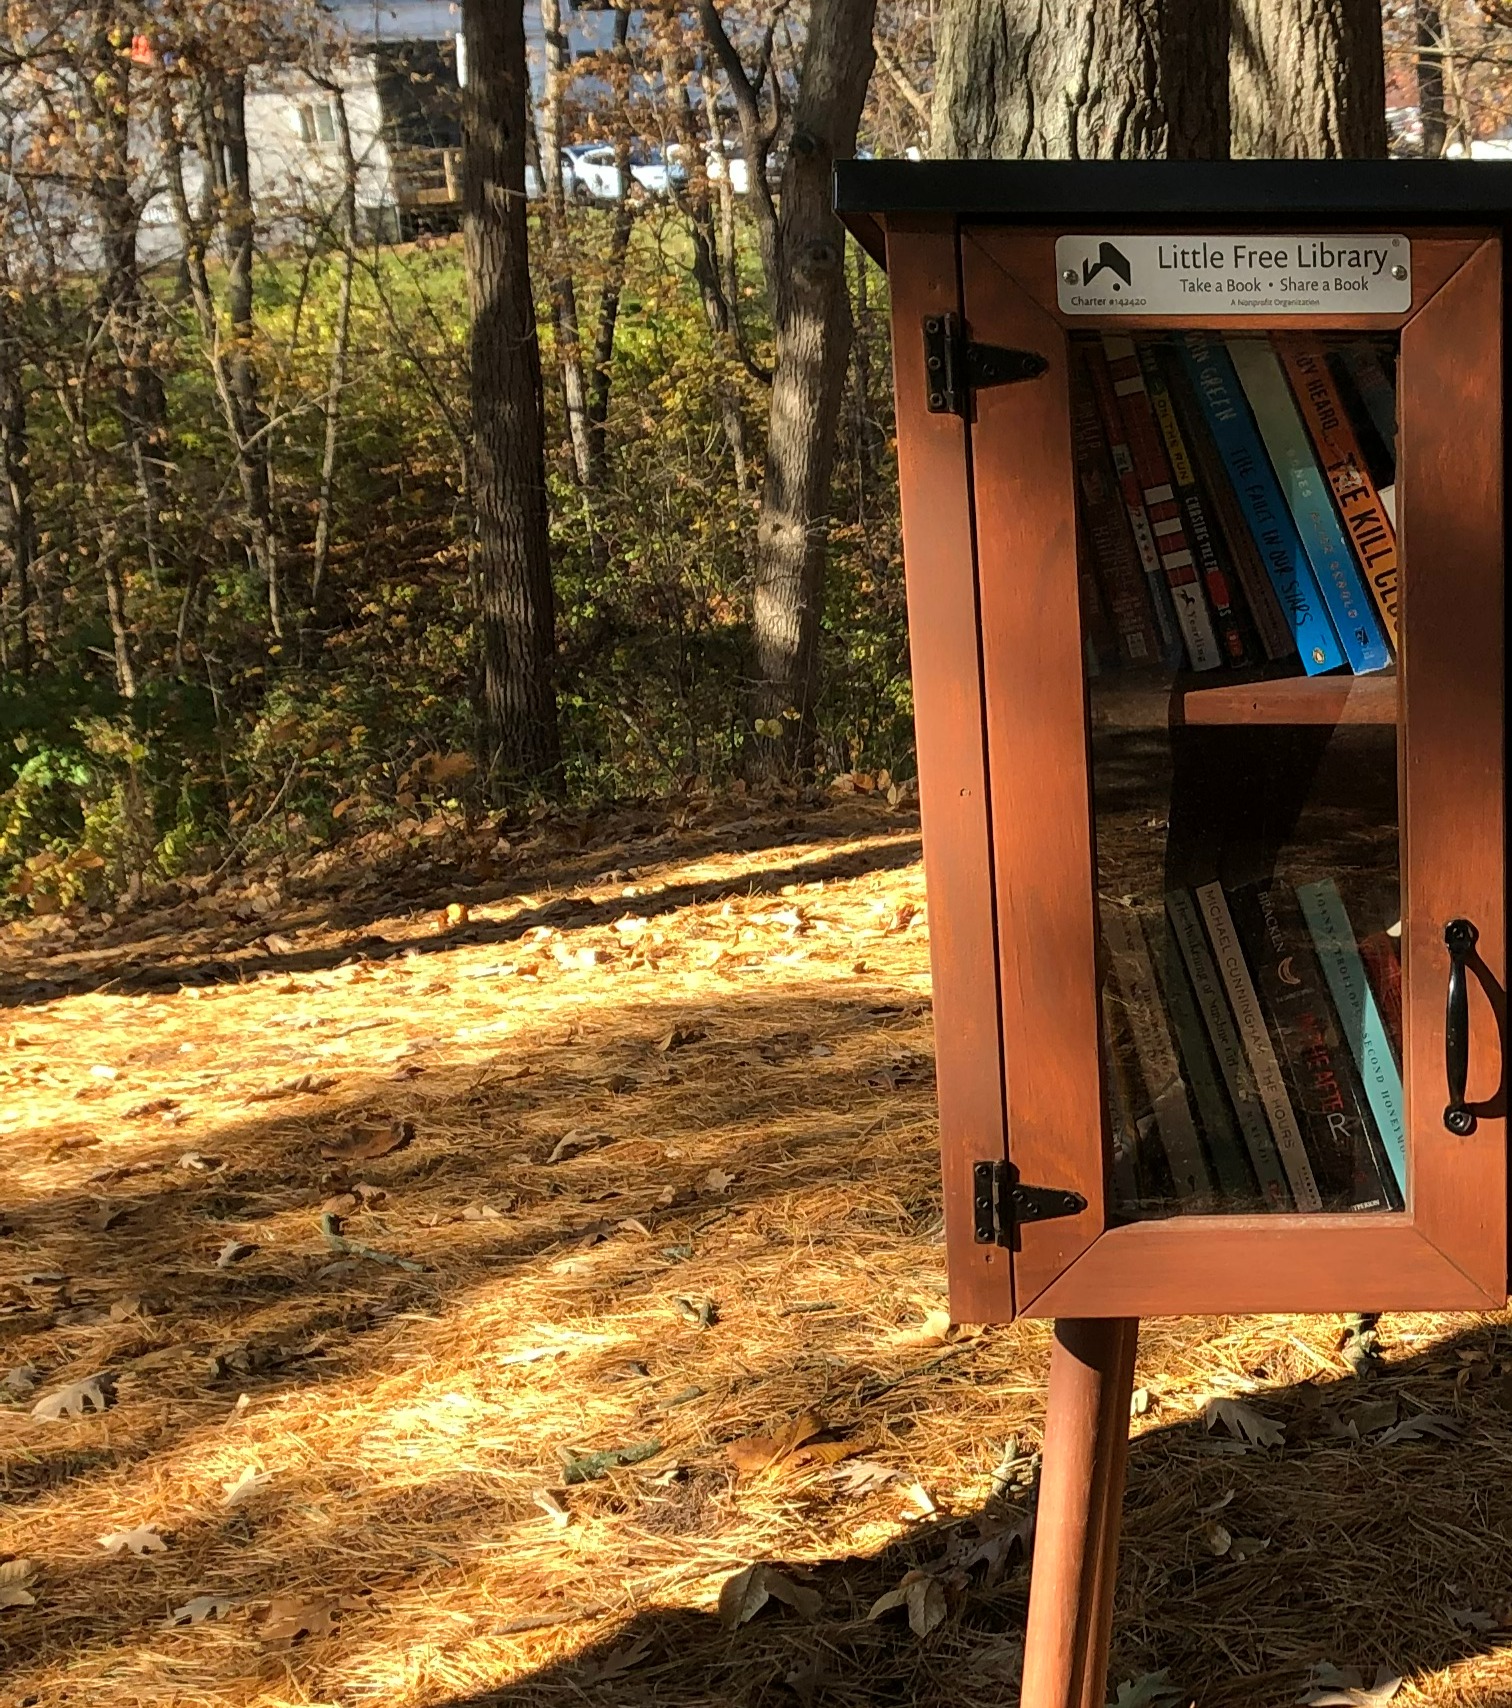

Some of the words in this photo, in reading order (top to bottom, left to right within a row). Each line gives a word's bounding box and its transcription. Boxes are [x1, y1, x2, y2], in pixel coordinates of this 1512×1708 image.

[1158, 242, 1224, 269] Little
[1233, 245, 1288, 269] Free
[1297, 241, 1388, 275] Library
[1071, 296, 1106, 306] Charter
[1179, 278, 1212, 293] Take
[1214, 281, 1223, 292] a
[1226, 278, 1262, 292] Book
[1280, 276, 1319, 291] Share
[1322, 279, 1331, 291] a
[1334, 275, 1369, 291] Book
[1196, 365, 1237, 424] GREEN
[1305, 377, 1341, 432] HEARD
[1163, 421, 1178, 448] THE
[1173, 451, 1189, 481] RUN
[1228, 445, 1259, 482] THE
[1184, 495, 1211, 542] CHASING
[1243, 481, 1277, 525] FAULT
[1261, 527, 1284, 549] IN
[1267, 546, 1295, 578] OUR
[1347, 507, 1396, 569] KILL
[1372, 566, 1401, 633] CLU
[1280, 578, 1316, 628] STARS
[1186, 610, 1209, 664] Yearling
[1256, 890, 1286, 954] BRACKEN
[1201, 983, 1216, 998] of
[1204, 889, 1233, 954] MICHAEL
[1225, 955, 1266, 1056] CUNNINGHAM
[1260, 1065, 1278, 1094] THE
[1270, 1098, 1296, 1150] HOURS
[1360, 1031, 1385, 1084] SECOND
[1380, 1089, 1411, 1162] HONEYMO
